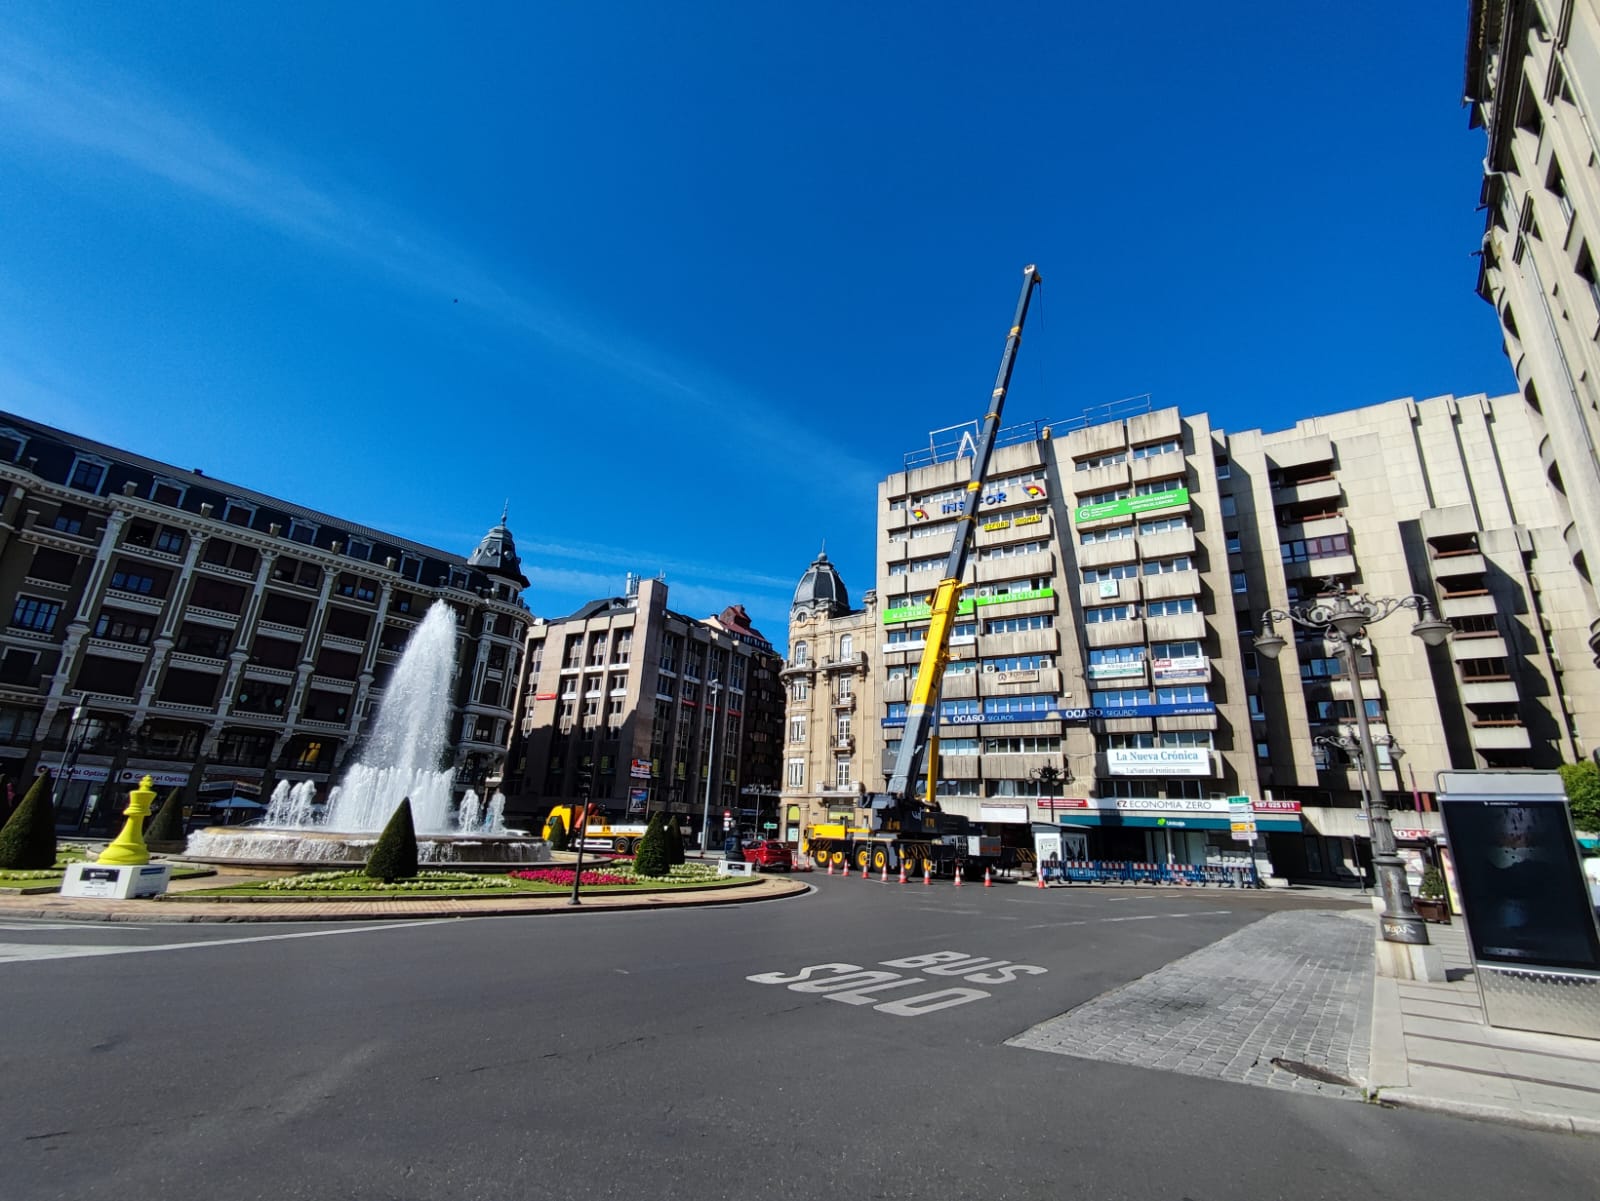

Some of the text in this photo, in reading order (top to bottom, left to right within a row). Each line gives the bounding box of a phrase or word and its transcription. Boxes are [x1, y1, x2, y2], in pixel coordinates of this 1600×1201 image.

[1065, 708, 1138, 718] OCASO SEGUROS
[952, 713, 985, 724] OCASO
[1116, 750, 1199, 761] La Nueva Crónica
[83, 769, 108, 779] Optica
[164, 775, 188, 784] Optica
[1186, 801, 1212, 810] ZERO
[877, 950, 1049, 984] BUS
[745, 962, 992, 1017] SOLO
